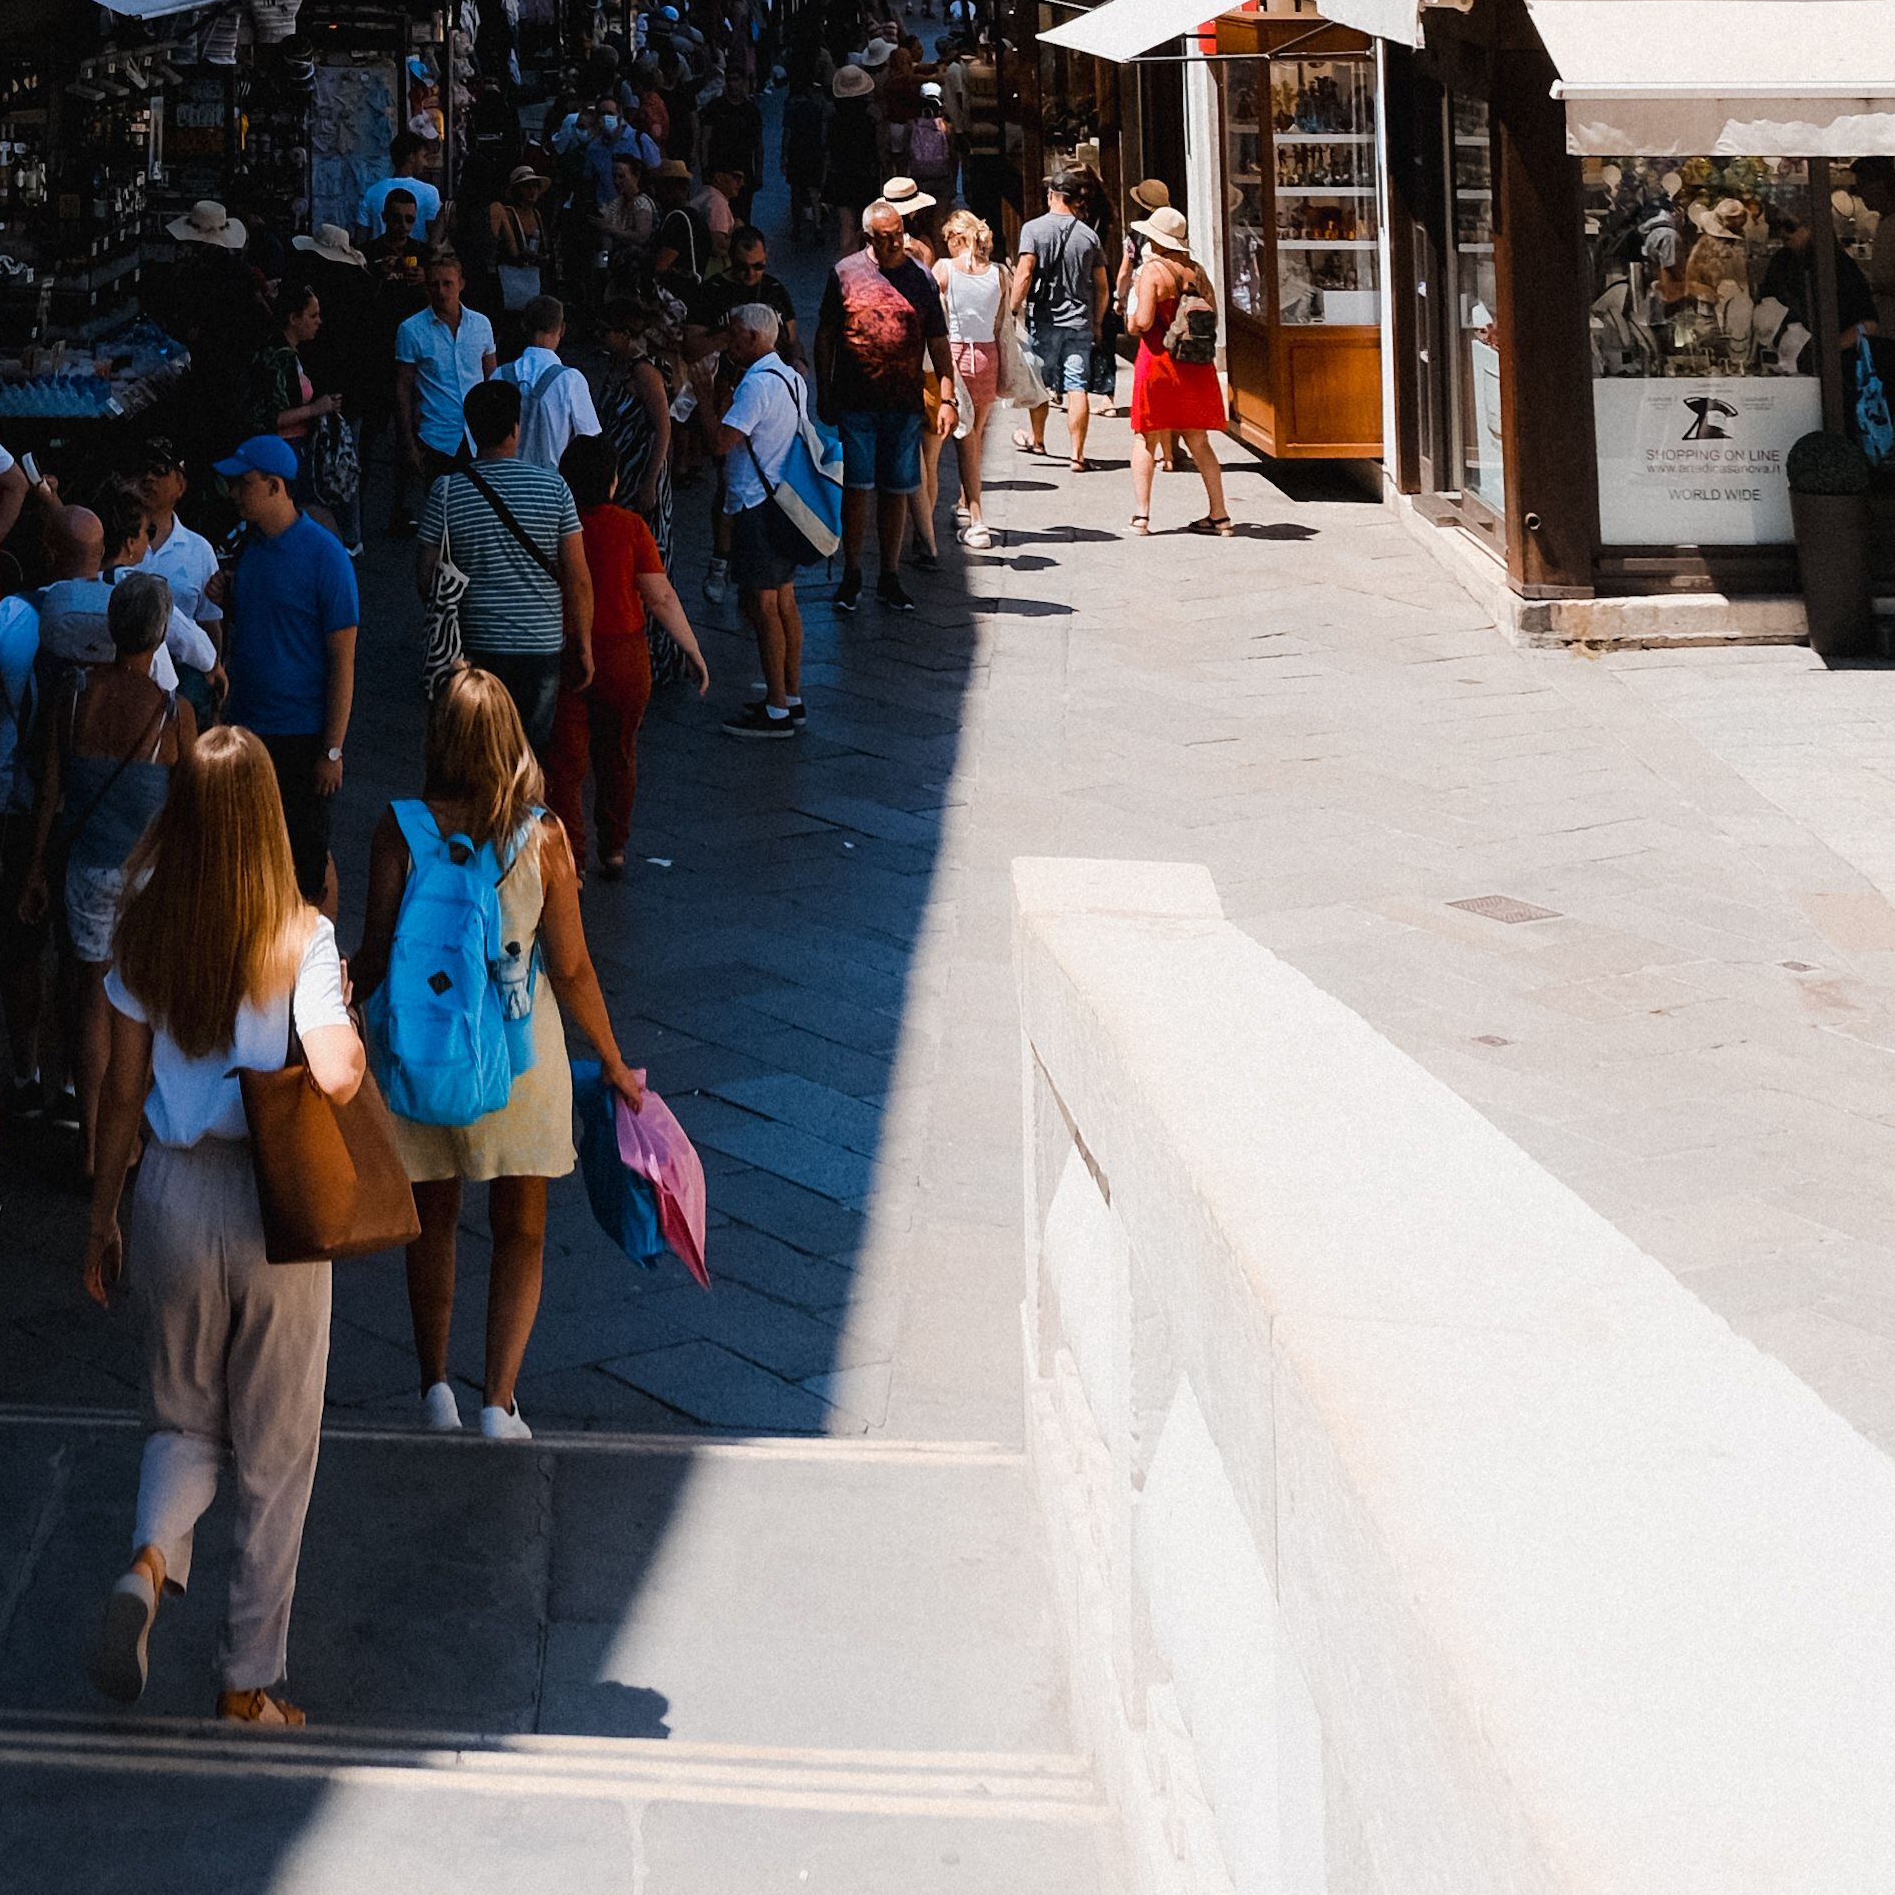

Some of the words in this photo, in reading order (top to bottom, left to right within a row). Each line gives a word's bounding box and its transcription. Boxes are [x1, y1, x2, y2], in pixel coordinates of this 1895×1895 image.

[1645, 449, 1721, 462] SHOPPING
[1724, 449, 1746, 462] ON
[1749, 449, 1781, 462] LINE
[1669, 488, 1721, 501] WORLD
[1724, 488, 1762, 501] WIDE
